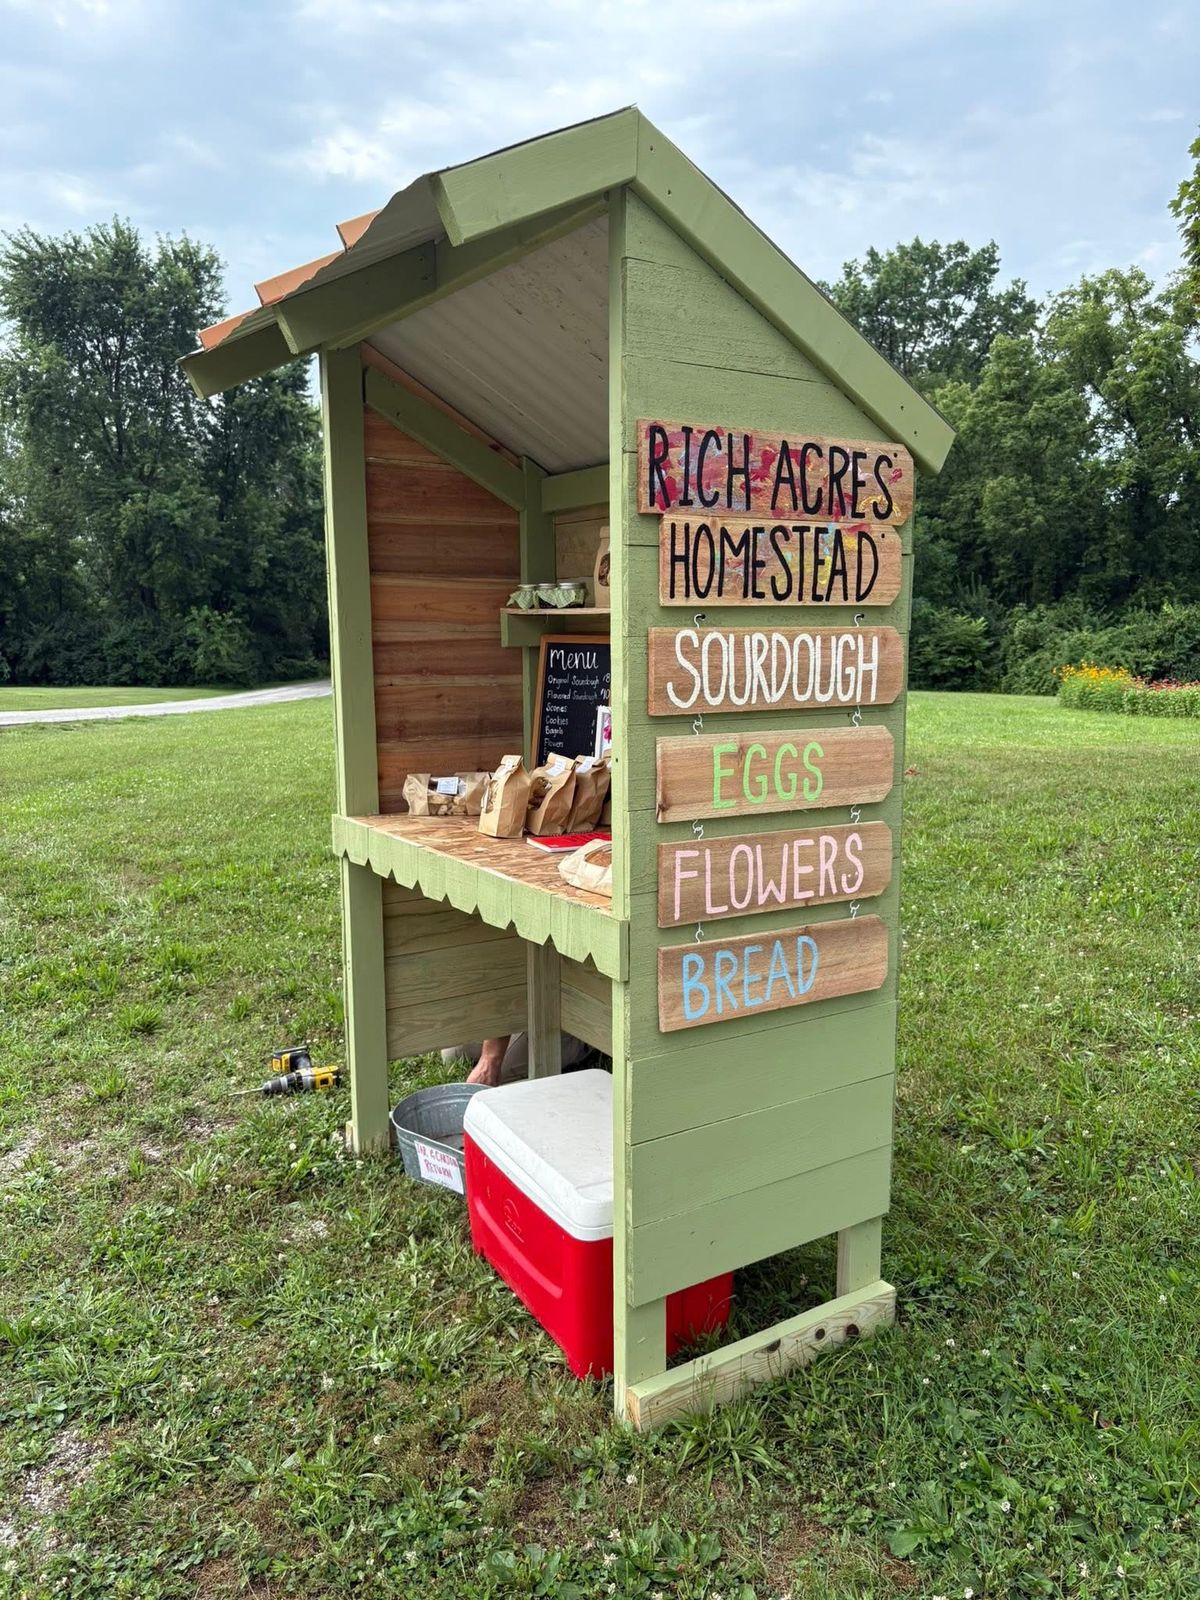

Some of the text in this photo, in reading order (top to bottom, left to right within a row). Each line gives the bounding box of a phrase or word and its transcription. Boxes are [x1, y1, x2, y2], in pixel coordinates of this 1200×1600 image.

[649, 425, 893, 520] RICH ACRES
[669, 522, 879, 602] HOMESTEAD
[550, 649, 599, 670] Menu
[571, 675, 600, 688] Sourdough
[666, 629, 878, 709] SOURDOUGH
[545, 702, 568, 713] Scones
[545, 715, 569, 726] Cookies
[713, 741, 825, 809] EGGS
[674, 832, 864, 921] FLOWERS
[682, 935, 820, 1022] BREAD
